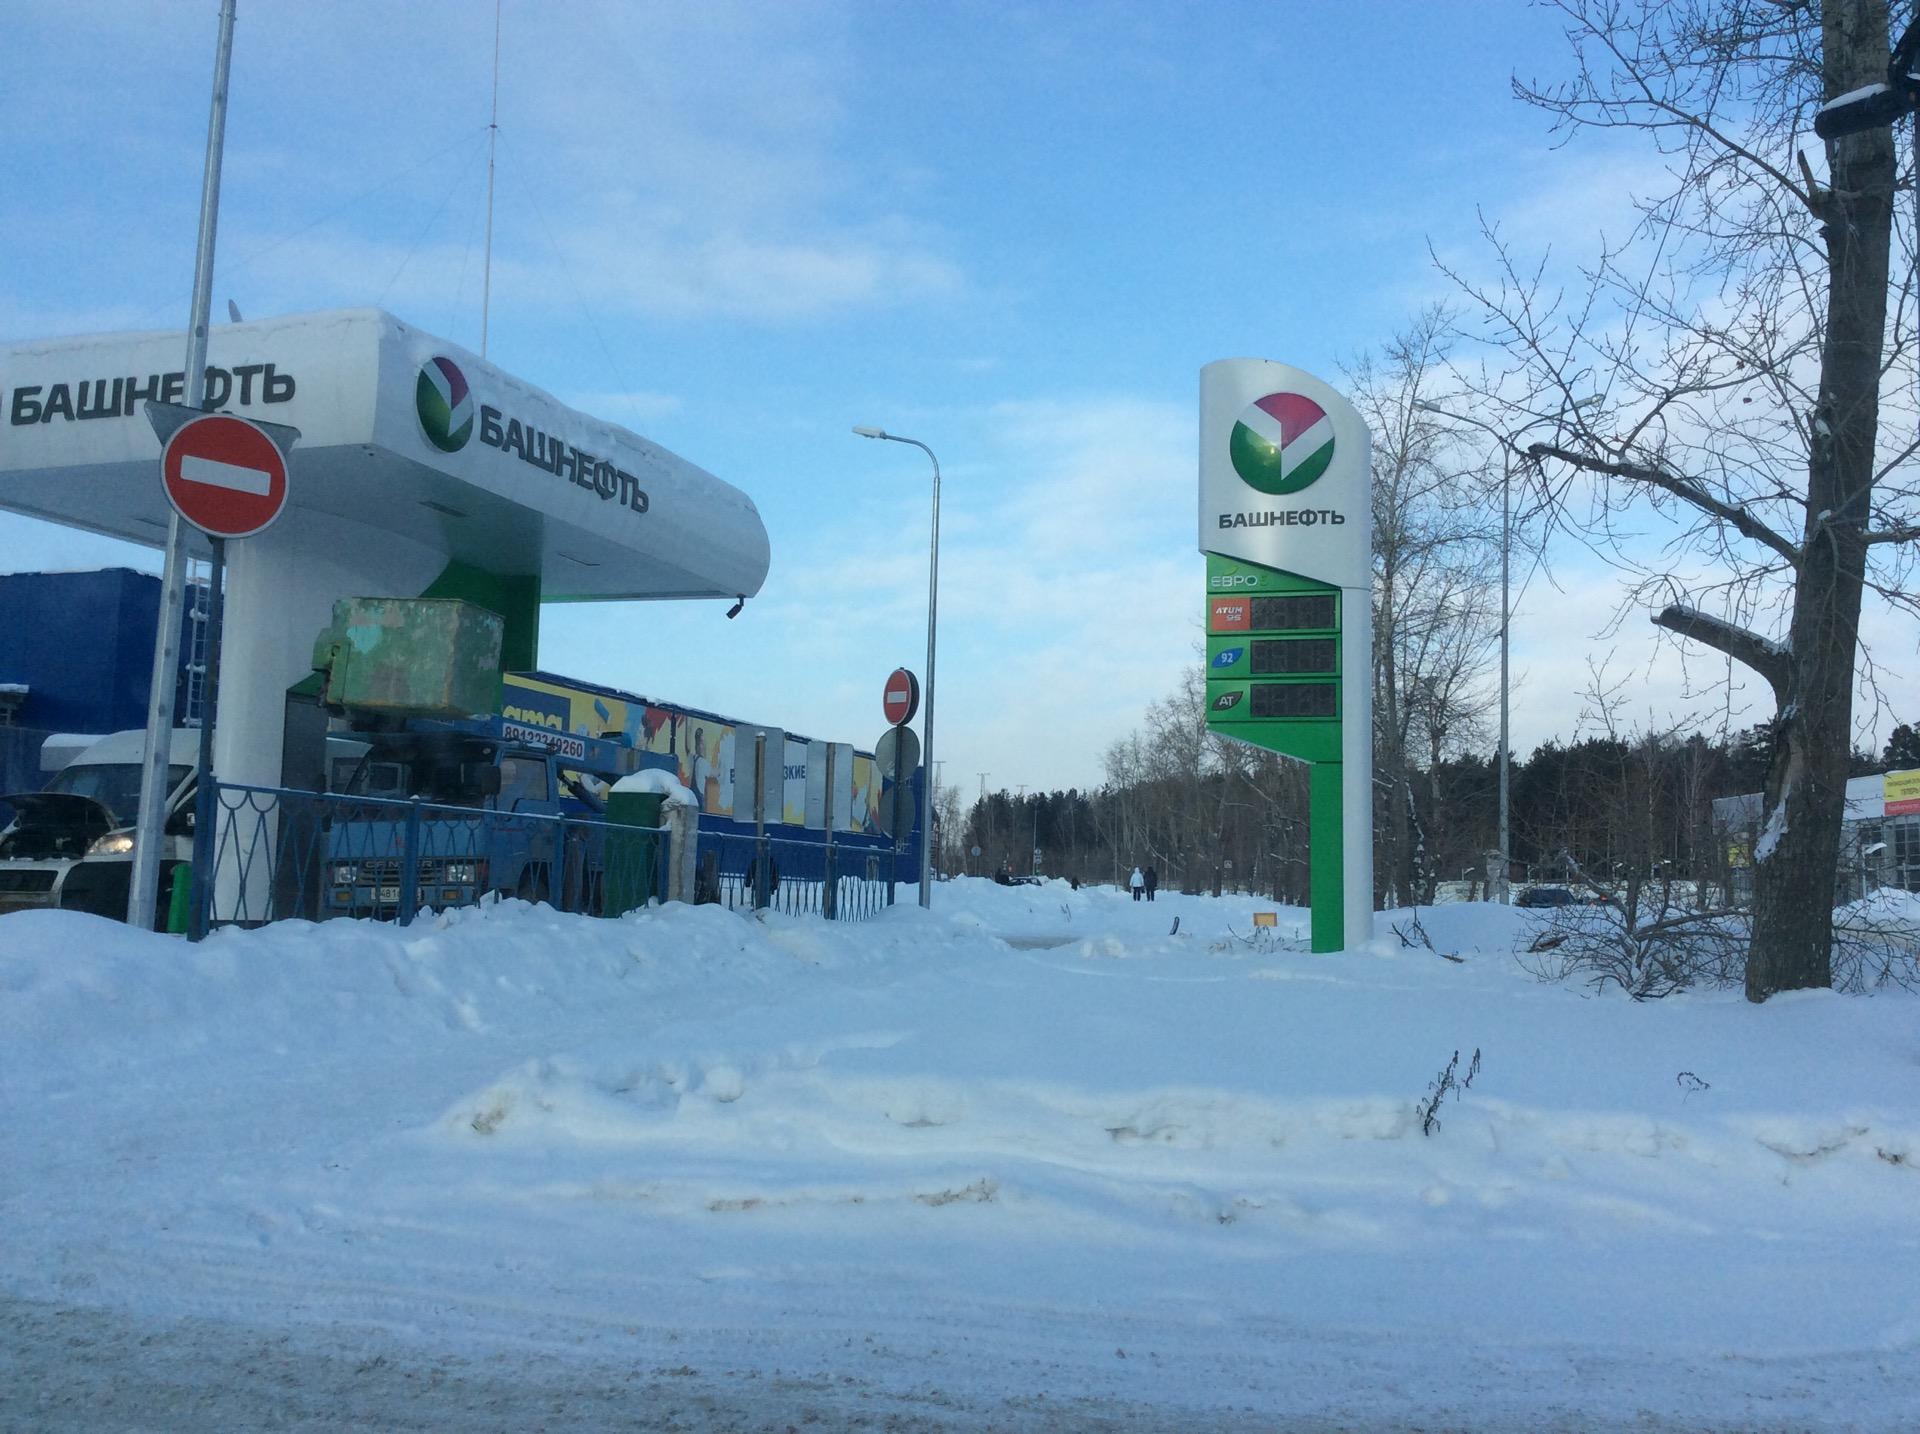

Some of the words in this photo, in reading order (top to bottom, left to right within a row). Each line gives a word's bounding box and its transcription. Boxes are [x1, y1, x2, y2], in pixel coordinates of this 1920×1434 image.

[11, 363, 296, 426] БАШНЕФТЬ
[479, 405, 649, 513] БАШНЕФТЬ
[1218, 509, 1345, 529] БАШНЕФТЬ
[1210, 575, 1258, 587] ЕВРО
[1221, 652, 1234, 664] 92
